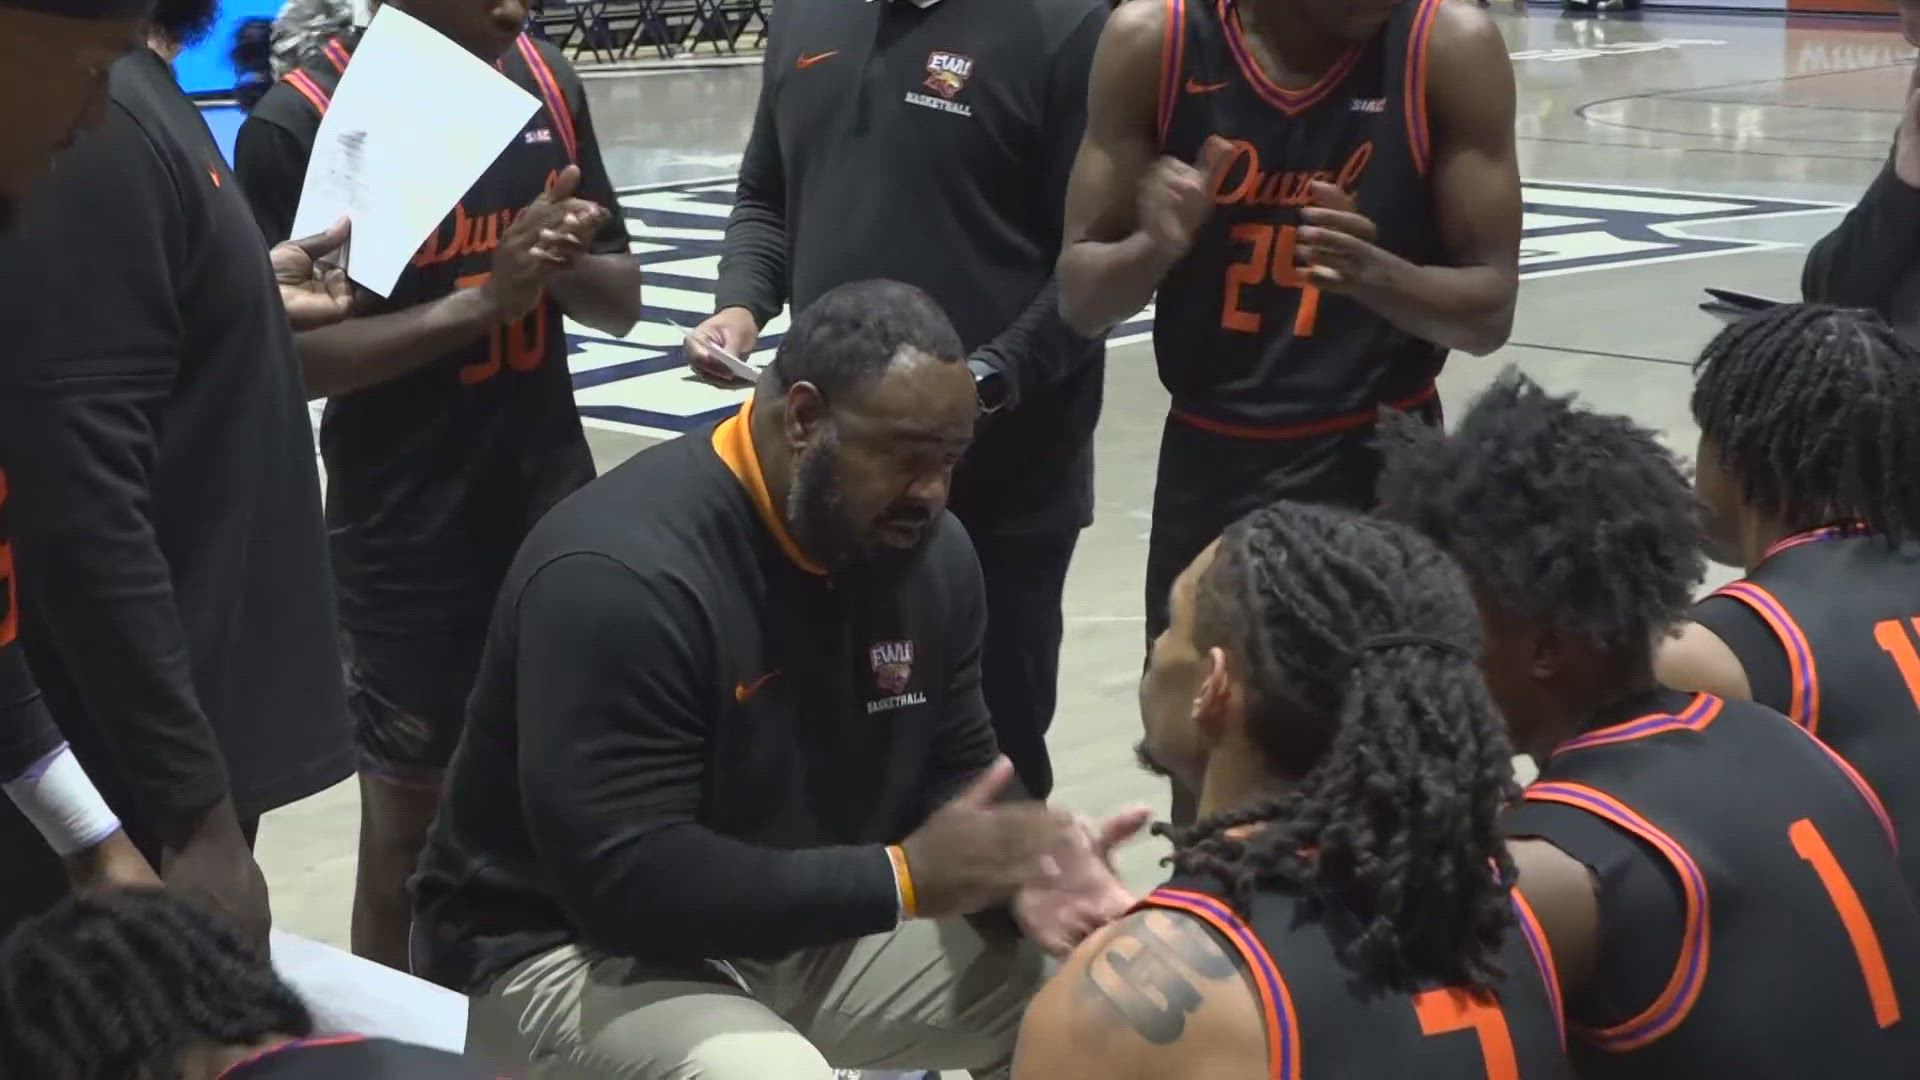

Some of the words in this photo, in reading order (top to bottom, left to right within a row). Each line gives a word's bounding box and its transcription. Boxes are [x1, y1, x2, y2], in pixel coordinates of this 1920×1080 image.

[904, 91, 972, 117] BASKETBALL
[866, 692, 927, 714] BASKETBALL
[1788, 818, 1900, 1029] 1
